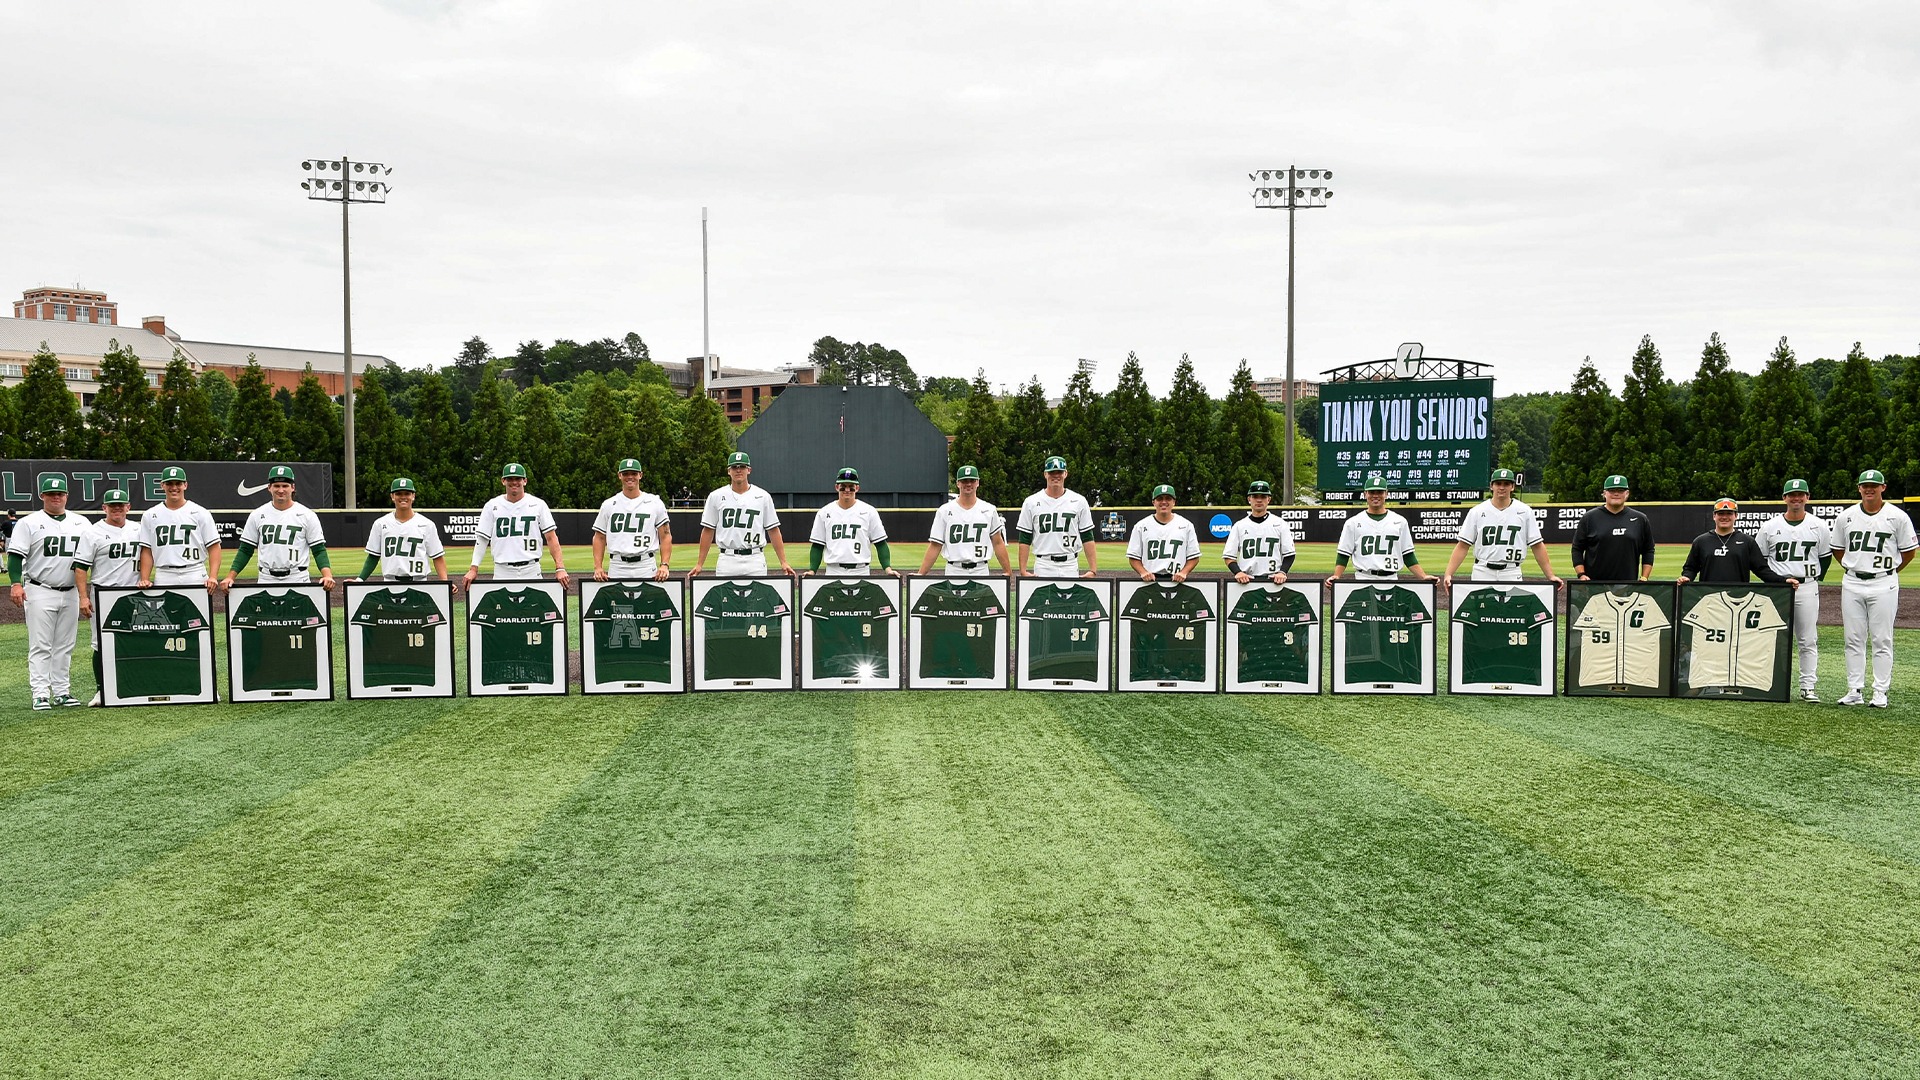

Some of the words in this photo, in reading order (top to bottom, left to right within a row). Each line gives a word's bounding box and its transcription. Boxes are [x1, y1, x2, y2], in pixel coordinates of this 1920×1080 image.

[1323, 401, 1373, 442] THANK
[1380, 400, 1410, 441] YOU
[1418, 397, 1487, 440] SENIORS
[1337, 452, 1351, 460] #35
[1356, 451, 1370, 460] #36
[1379, 451, 1388, 459] #3
[1398, 450, 1410, 459] #51
[1417, 450, 1431, 459] #44
[1438, 450, 1448, 458] #9
[1455, 450, 1470, 458] #46
[1347, 471, 1361, 479] #37
[1387, 470, 1401, 478] #40
[1408, 470, 1421, 478] #19
[1428, 470, 1441, 478] #18
[1447, 469, 1458, 478] #11
[1319, 510, 1346, 519] 2023
[1559, 509, 1586, 518] 2013
[1812, 506, 1844, 516] 1993
[610, 512, 650, 533] CLT
[722, 508, 760, 528] CLT
[1039, 512, 1077, 534] CLT
[496, 516, 535, 538] CLT
[832, 524, 861, 540] CLT
[950, 523, 987, 544] CLT
[155, 524, 197, 546] CLT
[262, 525, 303, 545] CLT
[634, 536, 650, 547] 52
[744, 532, 760, 545] 44
[1063, 536, 1077, 547] 37
[1482, 526, 1521, 546] CLT
[1849, 531, 1892, 552] CLT
[44, 536, 80, 557] CLT
[109, 542, 140, 558] CLT
[385, 537, 423, 558] CLT
[524, 538, 536, 551] 19
[854, 543, 860, 554] 9
[1148, 540, 1183, 560] CLT
[1242, 537, 1279, 559] CLT
[1361, 535, 1400, 556] CLT
[182, 548, 200, 560] 40
[289, 549, 298, 561] 11
[975, 546, 987, 558] 51
[1506, 549, 1521, 560] 36
[1776, 541, 1817, 562] CLT
[409, 561, 423, 573] 18
[1269, 560, 1276, 571] 3
[1385, 558, 1398, 570] 35
[1873, 556, 1892, 569] 20
[1804, 565, 1816, 576] 16
[1630, 610, 1644, 628] C
[1745, 610, 1761, 628] C
[640, 628, 659, 640] 52
[747, 625, 767, 638] 44
[862, 624, 871, 636] 9
[967, 624, 982, 637] 51
[1070, 628, 1089, 641] 37
[1175, 627, 1194, 640] 46
[1389, 630, 1409, 643] 35
[1706, 629, 1725, 642] 25
[289, 635, 302, 648] 11
[408, 634, 424, 647] 18
[526, 632, 542, 645] 19
[1284, 632, 1293, 645] 3
[1508, 632, 1528, 645] 36
[1592, 631, 1610, 644] 59
[165, 638, 186, 651] 40
